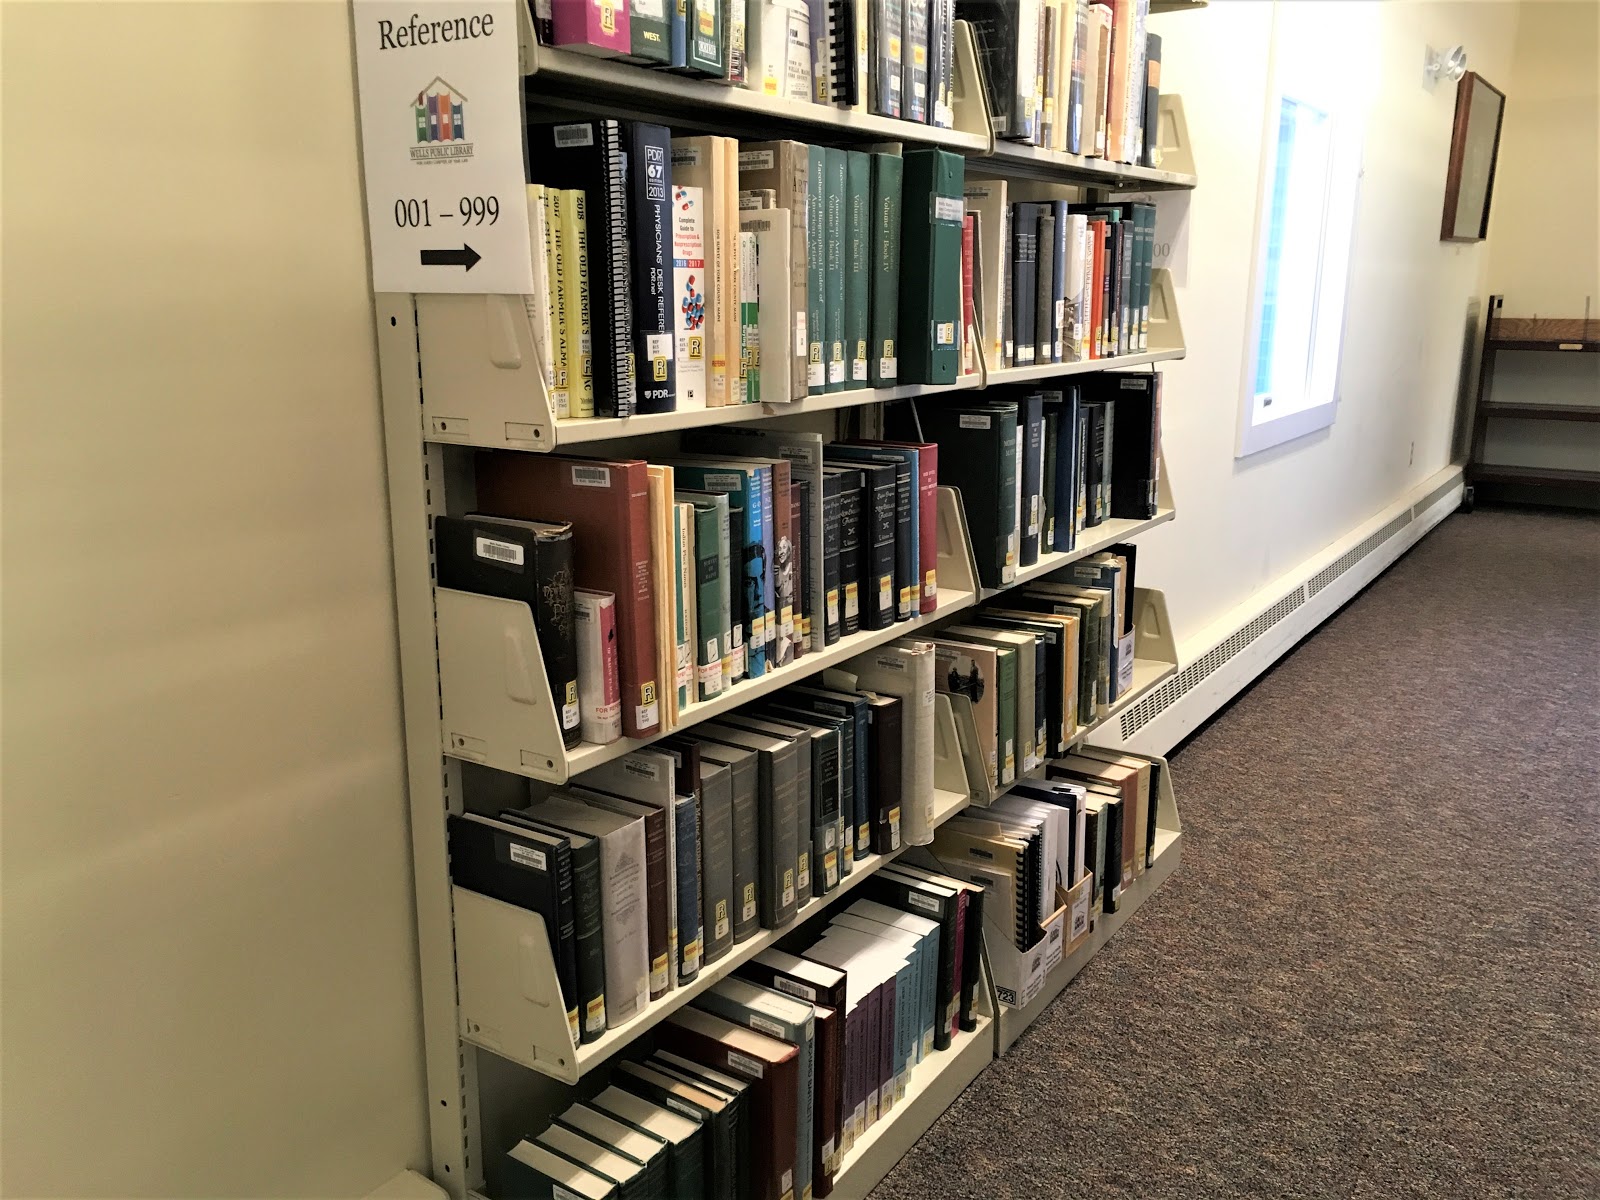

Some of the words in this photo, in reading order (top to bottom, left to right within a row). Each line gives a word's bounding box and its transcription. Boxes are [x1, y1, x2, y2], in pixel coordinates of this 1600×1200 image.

[378, 13, 494, 50] Reference
[410, 149, 429, 158] WELLS
[430, 148, 449, 157] PUBLIC
[450, 146, 473, 156] LIBRARY
[647, 148, 663, 161] PDR
[647, 165, 662, 178] 67
[648, 186, 664, 198] 2013
[394, 199, 431, 227] 001
[459, 196, 500, 226] 999
[576, 196, 584, 220] 2018
[579, 255, 587, 277] OLD
[883, 262, 889, 272] IV
[656, 269, 664, 293] DESK
[819, 294, 824, 303] of
[557, 280, 566, 335] FARMER'S
[580, 281, 590, 335] FARMER'S
[657, 296, 665, 335] REFEREN
[691, 339, 701, 355] R
[656, 358, 666, 375] R
[652, 389, 668, 399] PDR
[645, 686, 654, 702] R
[997, 990, 1014, 1003] 723
